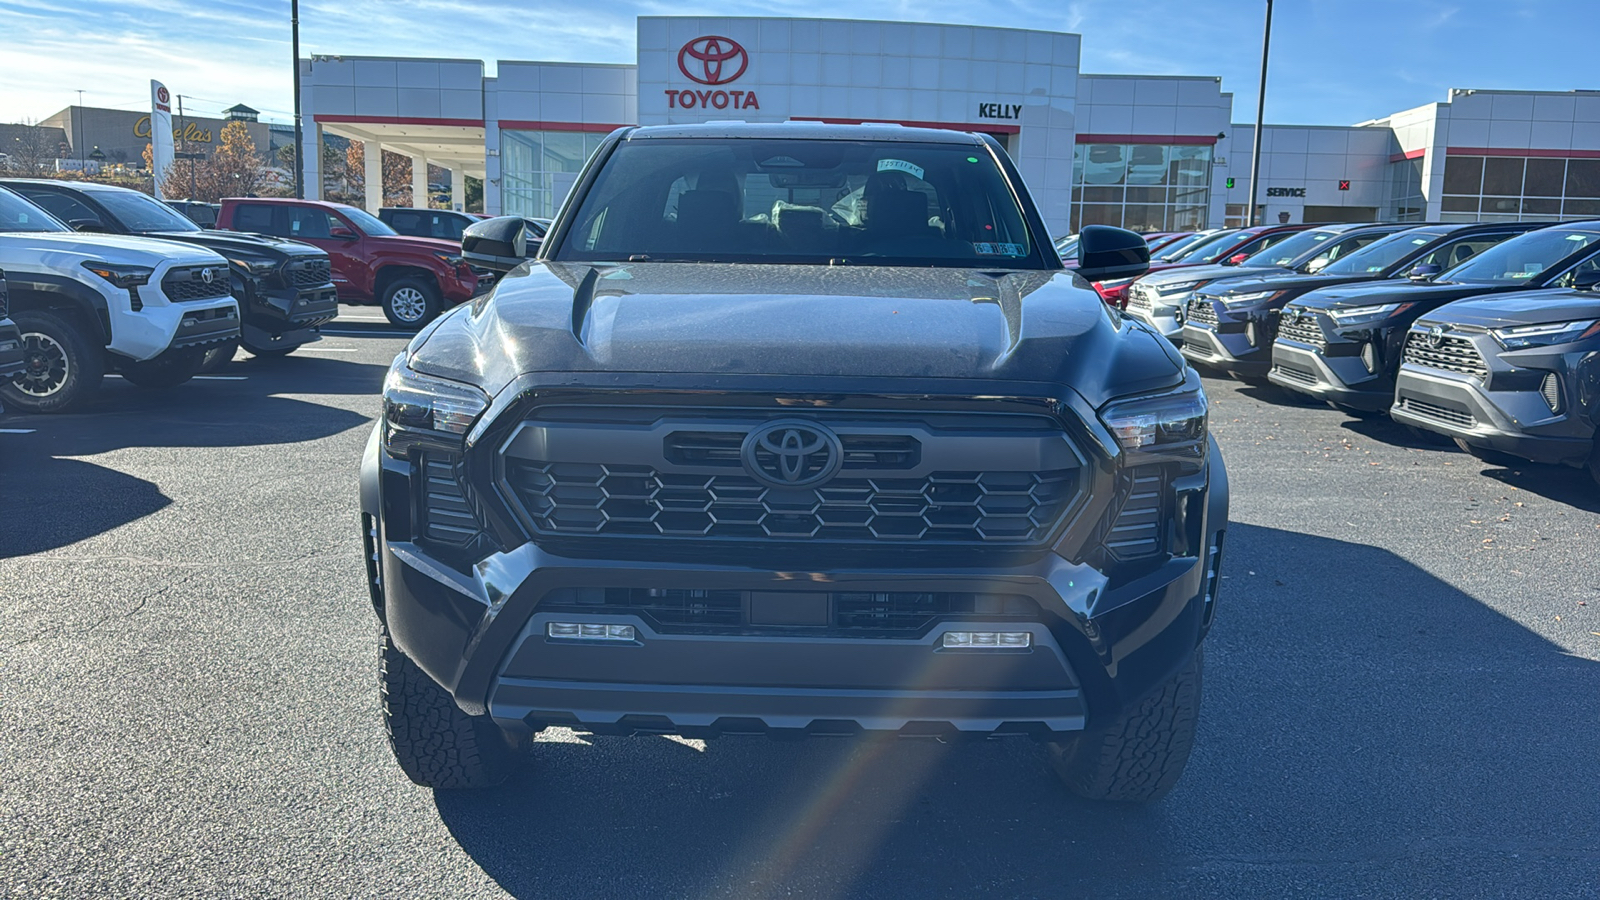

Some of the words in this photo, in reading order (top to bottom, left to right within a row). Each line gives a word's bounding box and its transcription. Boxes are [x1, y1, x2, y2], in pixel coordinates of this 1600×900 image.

[664, 89, 760, 110] TOYOTA
[978, 102, 1023, 120] KELLY
[134, 116, 212, 143] Cela's
[1266, 187, 1307, 198] SERVICE
